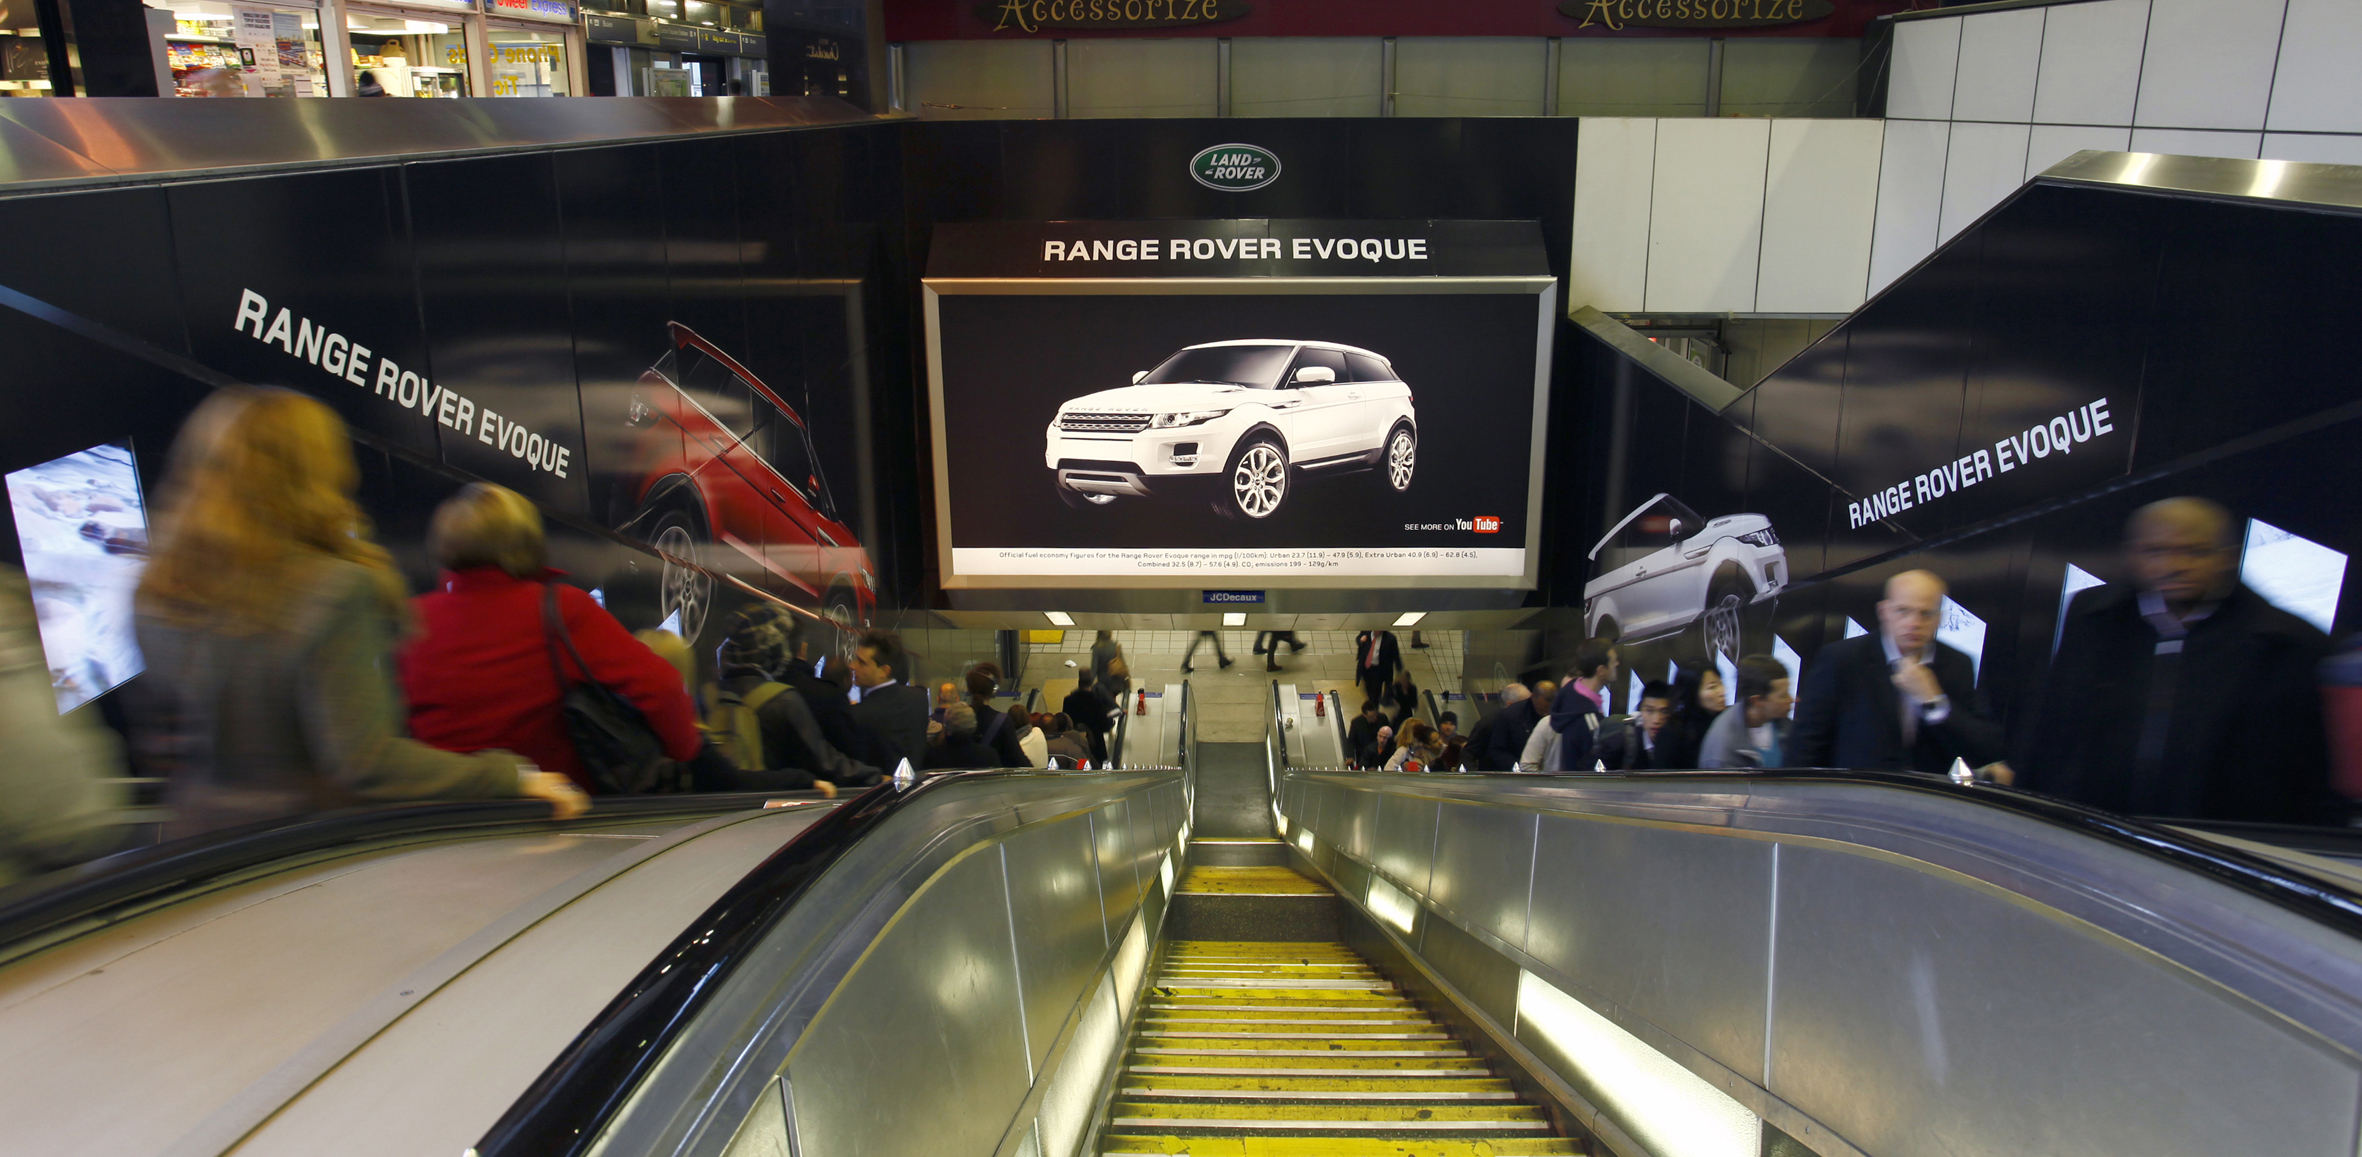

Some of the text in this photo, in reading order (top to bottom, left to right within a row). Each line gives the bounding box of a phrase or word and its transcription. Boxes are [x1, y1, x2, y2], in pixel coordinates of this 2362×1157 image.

[531, 0, 567, 16] Express
[993, 0, 1218, 33] Accessorize
[1578, 0, 1803, 31] Accessorize
[1210, 153, 1252, 166] LAND
[1213, 166, 1265, 179] ROVER
[1043, 237, 1428, 264] RANGE ROVER EVOQUE
[234, 288, 570, 479] RANGE ROVER EVOQUE
[1848, 397, 2113, 530] RANGE ROVER EVOQUE
[1404, 523, 1419, 531] SEE
[1420, 523, 1442, 531] MORE
[1443, 523, 1455, 531] ON
[1070, 552, 1095, 560] figures
[1121, 552, 1142, 560] Range
[1164, 552, 1189, 560] Evoque
[1308, 560, 1339, 569] 129g/km
[1210, 593, 1257, 602] JCDecaux
